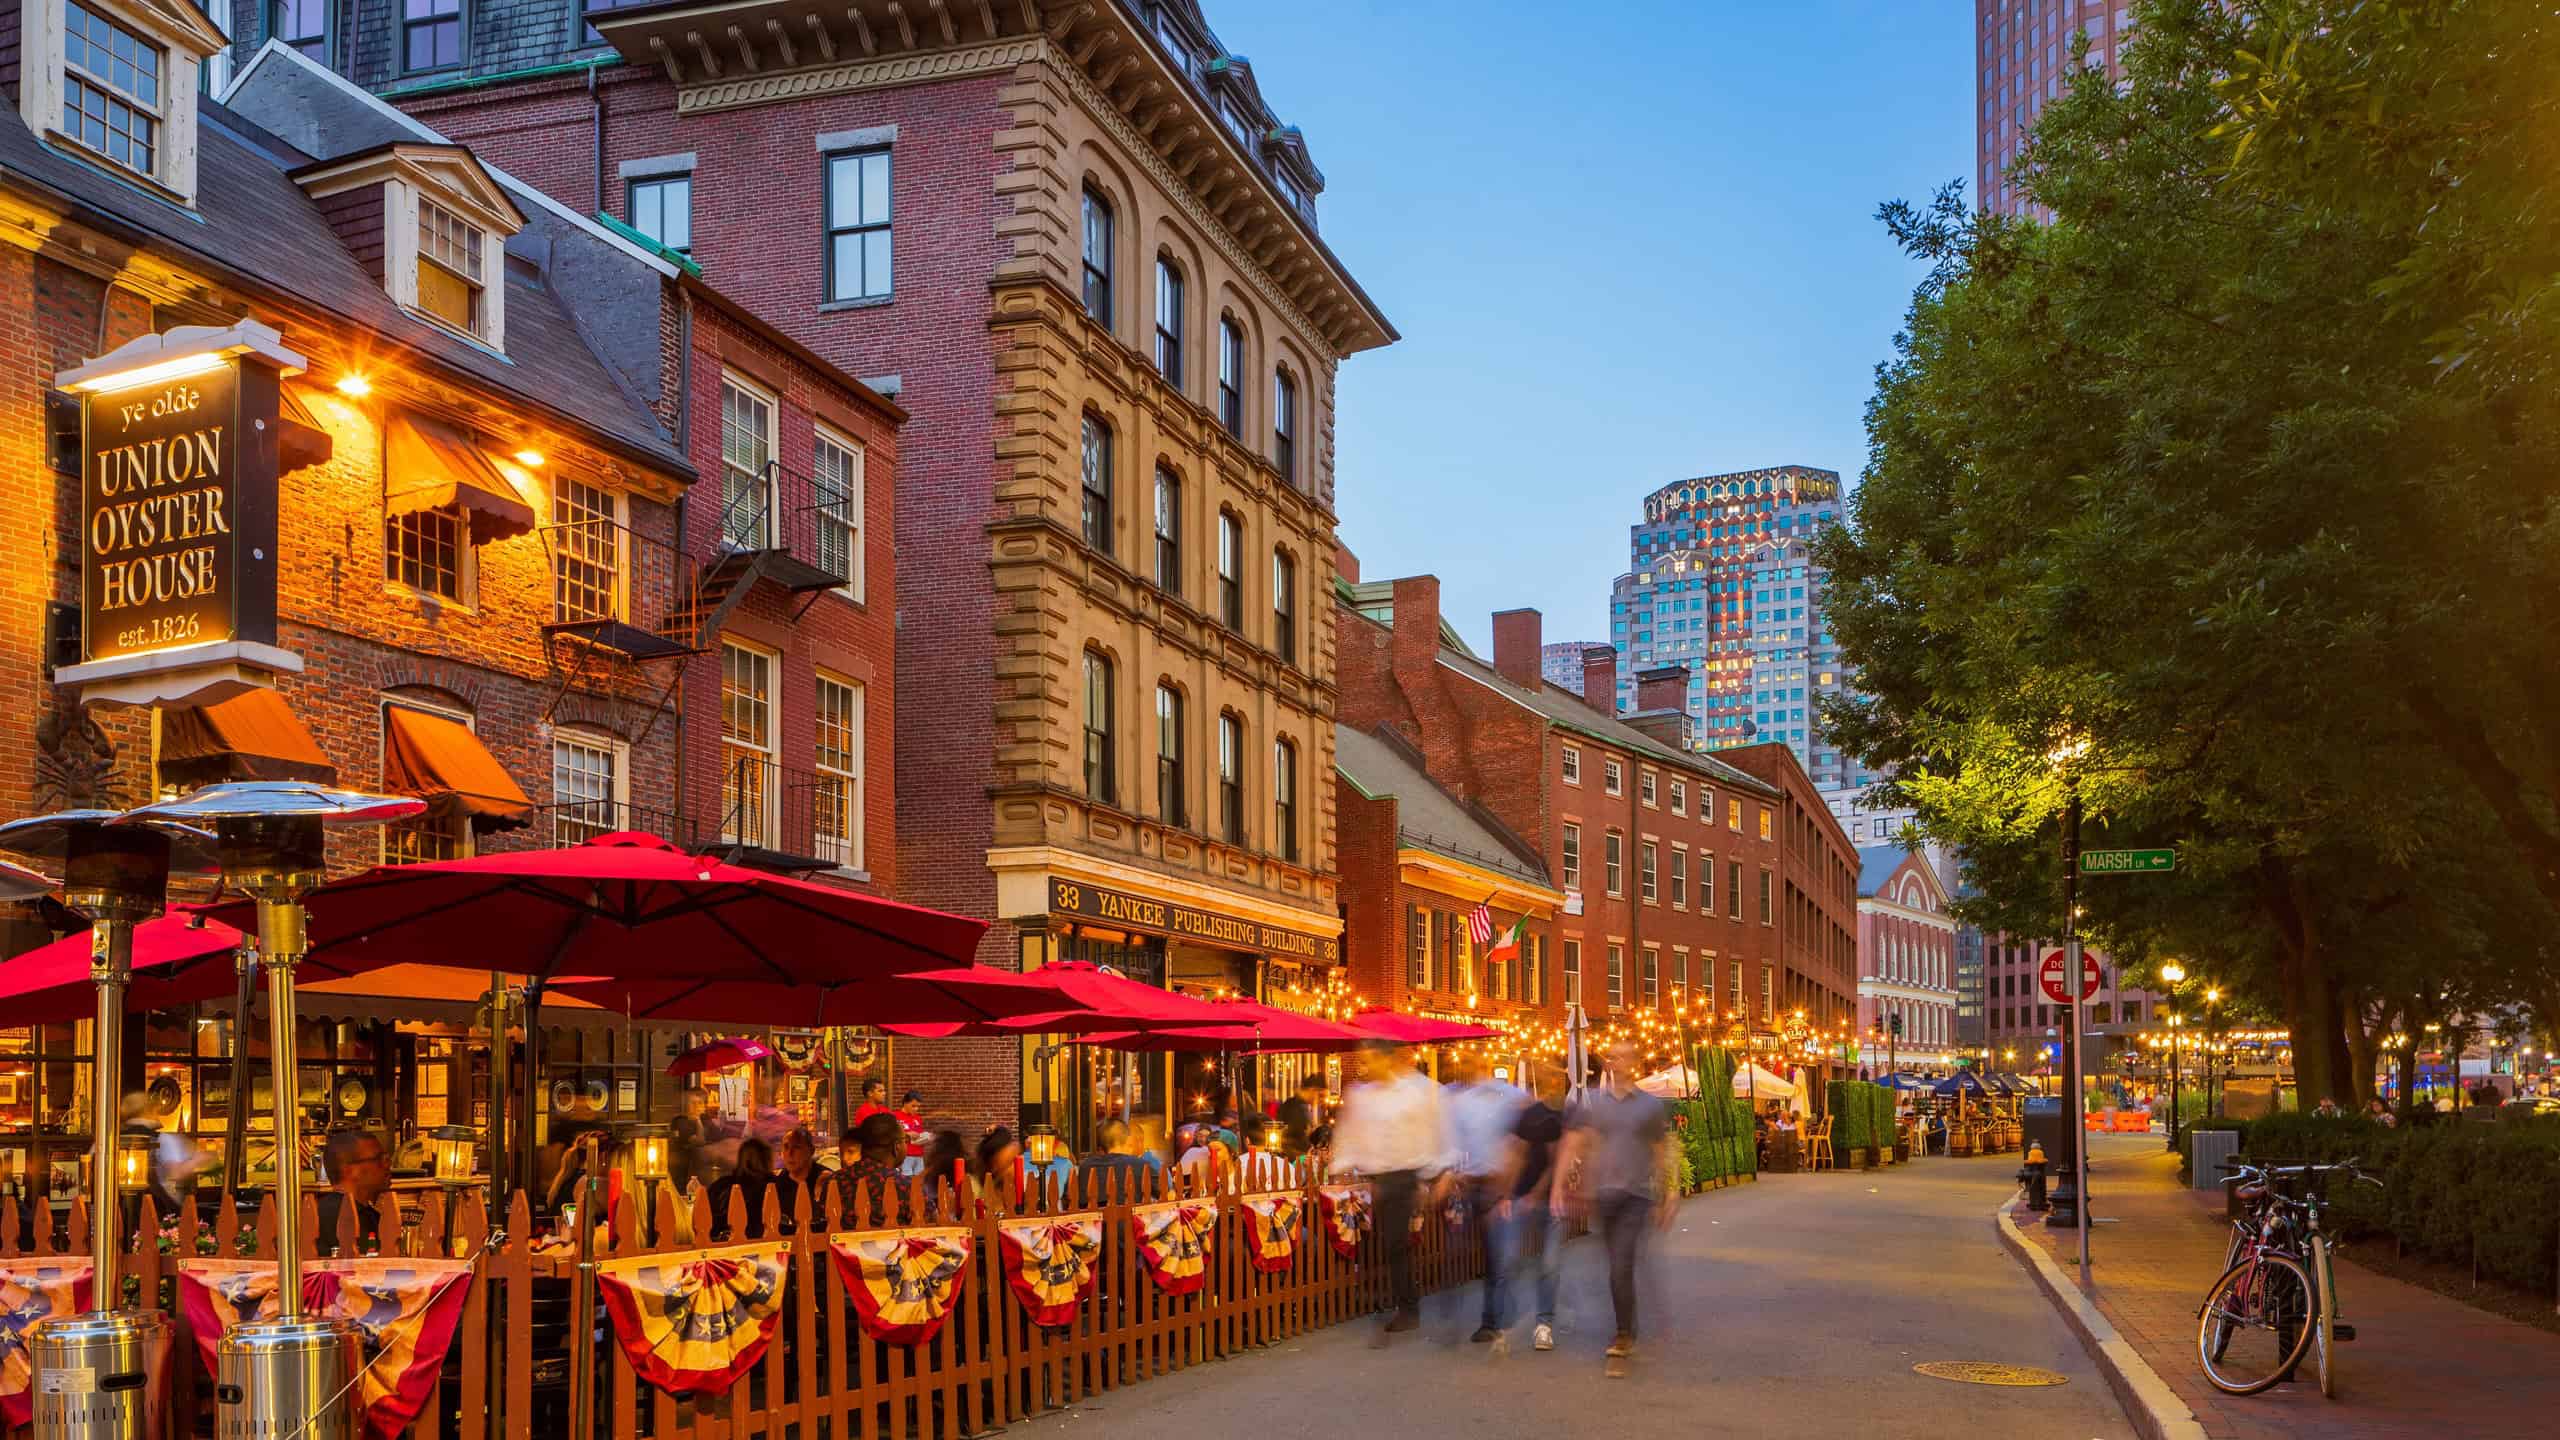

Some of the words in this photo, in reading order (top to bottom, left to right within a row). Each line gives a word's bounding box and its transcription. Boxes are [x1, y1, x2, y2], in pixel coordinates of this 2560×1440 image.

[121, 402, 145, 432] ye
[152, 384, 200, 418] olde
[97, 426, 223, 497] UNION
[92, 486, 231, 555] OYSTER
[100, 546, 217, 611] HOUSE
[2086, 853, 2133, 869] MARSH
[1057, 884, 1079, 910] 33
[1097, 891, 1165, 927] YANKEE
[1173, 908, 1255, 944] PUBLISHING
[1262, 929, 1315, 956] BUILDING
[1324, 942, 1337, 960] 33
